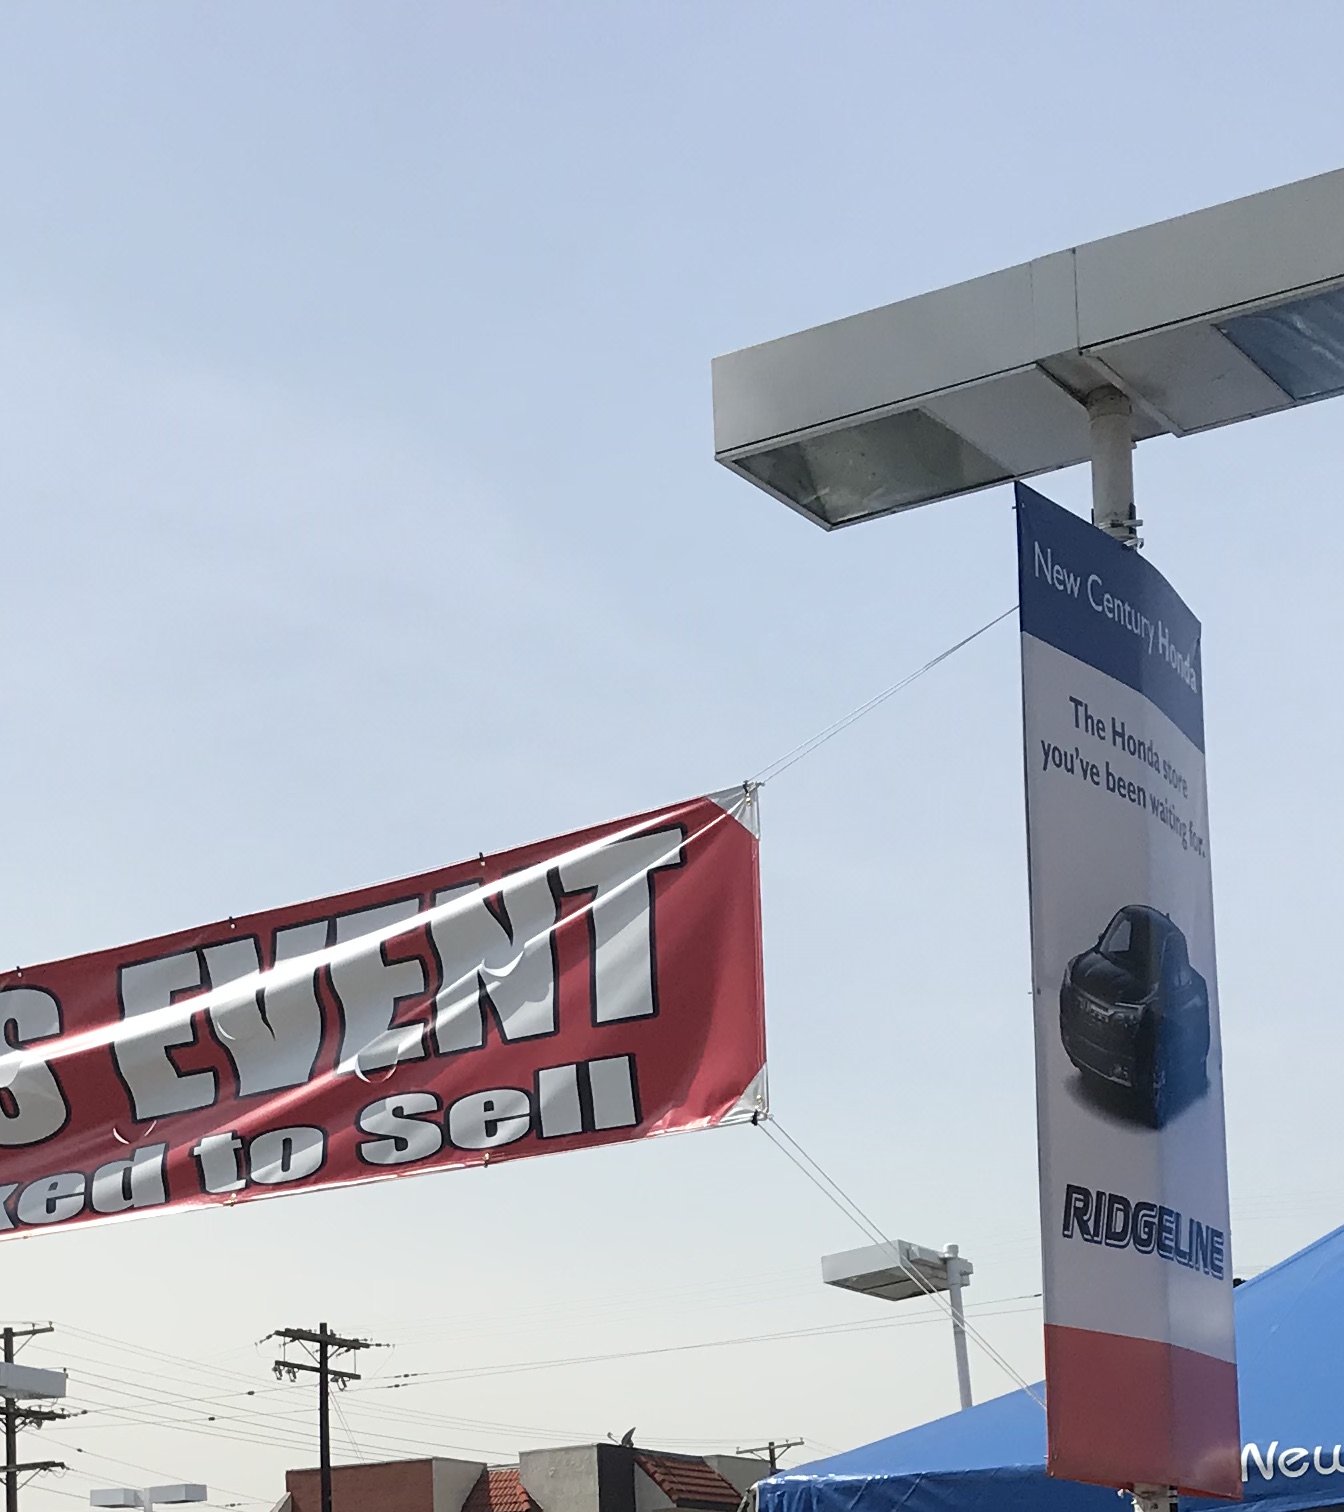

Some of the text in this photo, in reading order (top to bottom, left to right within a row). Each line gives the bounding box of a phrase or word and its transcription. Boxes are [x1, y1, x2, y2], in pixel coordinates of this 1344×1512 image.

[1034, 540, 1198, 694] New Century Honda
[1040, 739, 1206, 858] you've been waiting for.
[1069, 696, 1188, 800] The Honda store
[111, 823, 687, 1123] EVENT
[192, 1125, 329, 1195] to
[356, 1052, 639, 1168] Sell
[1062, 1183, 1224, 1281] RIDGELINE
